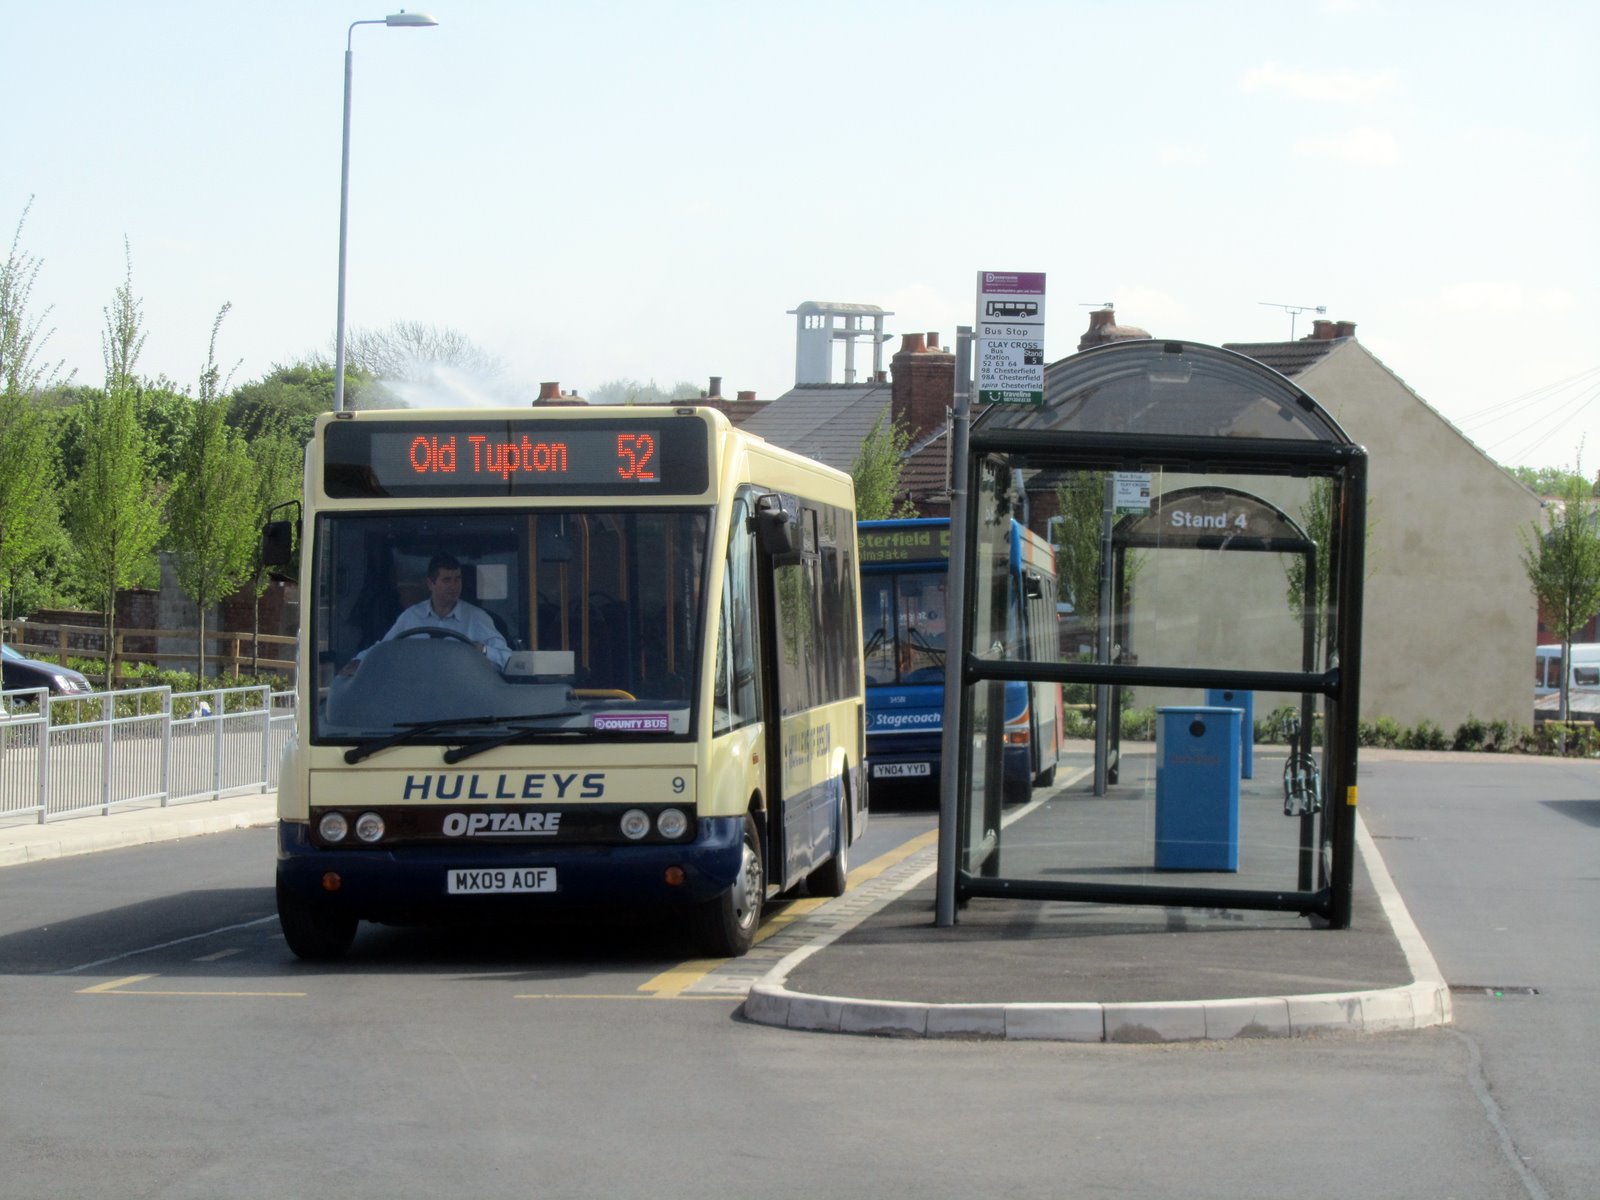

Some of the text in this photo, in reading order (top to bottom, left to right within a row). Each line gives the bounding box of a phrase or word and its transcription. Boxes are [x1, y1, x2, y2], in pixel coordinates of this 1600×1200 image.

[985, 327, 1028, 336] Bus Stop
[1010, 341, 1038, 349] CROSS
[409, 434, 654, 480] Old Tupton 52
[1171, 511, 1247, 528] Stand 4
[605, 719, 643, 729] COUNTY
[644, 719, 667, 728] BUS
[876, 711, 941, 727] Stagecoach
[878, 764, 926, 775] YN04 YYD
[402, 773, 606, 800] HULLEYS
[672, 776, 685, 794] 9
[442, 812, 562, 836] OPTARE
[456, 871, 548, 890] MX09 AOF
